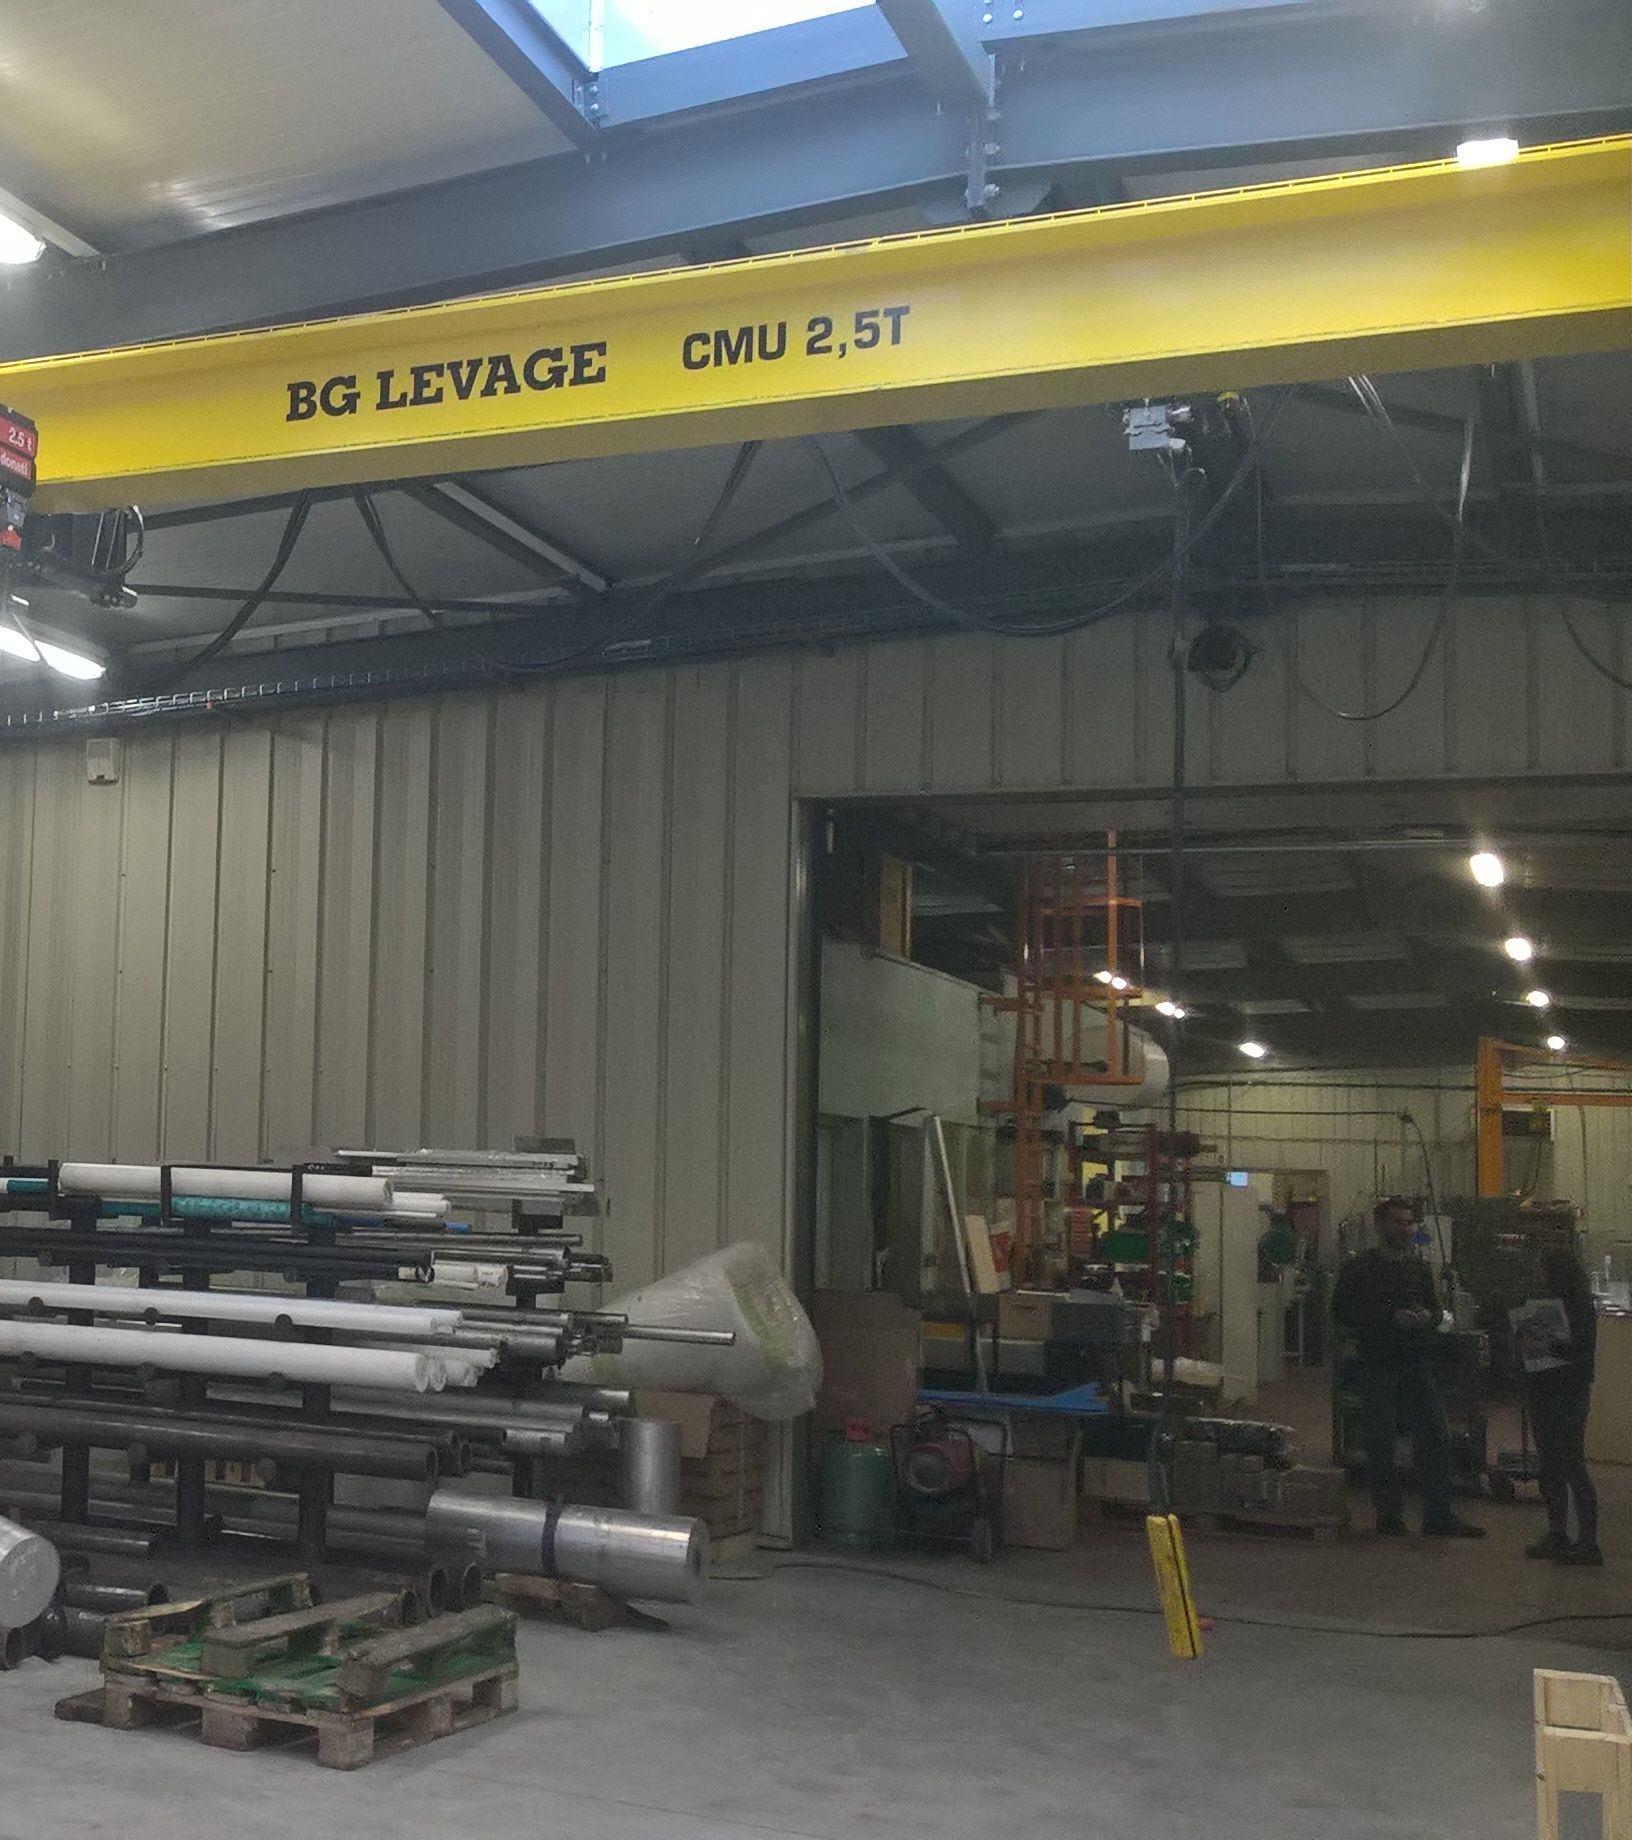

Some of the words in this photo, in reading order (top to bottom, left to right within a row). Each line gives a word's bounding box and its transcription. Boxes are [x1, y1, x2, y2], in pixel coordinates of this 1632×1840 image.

[682, 321, 787, 370] CMU
[806, 305, 911, 359] 2,5T
[285, 374, 361, 422] BG
[375, 341, 608, 411] LEVAGE
[0, 450, 29, 477] donati
